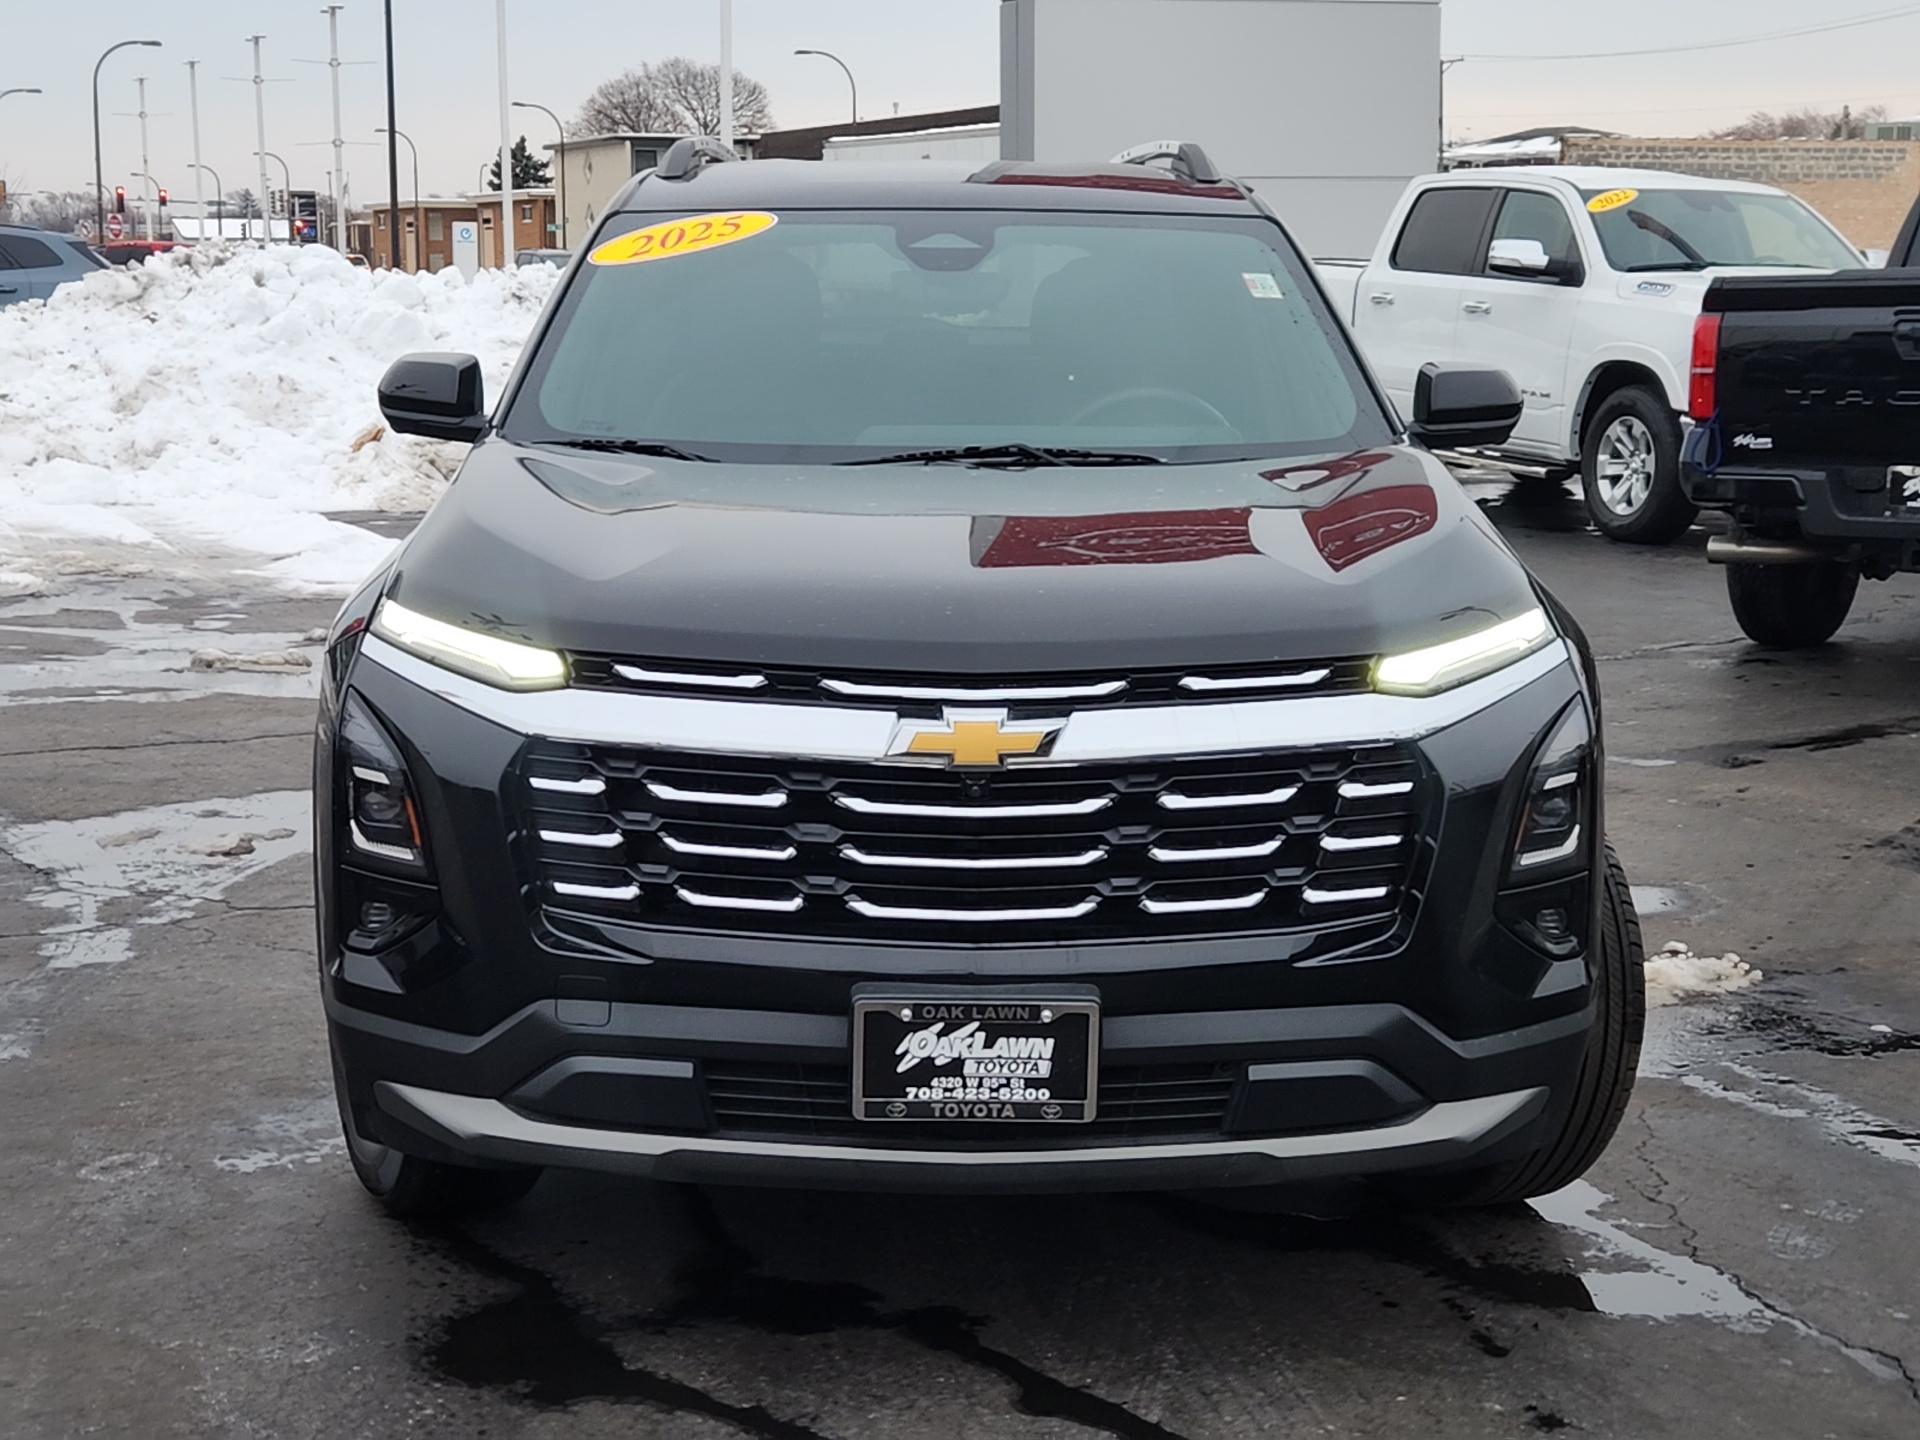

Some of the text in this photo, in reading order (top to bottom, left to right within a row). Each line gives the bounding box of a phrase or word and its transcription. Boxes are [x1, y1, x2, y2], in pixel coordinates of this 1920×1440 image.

[1597, 190, 1630, 209] 2022
[627, 214, 744, 259] 2025
[922, 1005, 1030, 1020] OAK LAWN
[974, 1060, 1040, 1075] TOYOTA
[930, 1077, 963, 1088] 4320
[966, 1077, 980, 1088] W
[1010, 1077, 1025, 1089] St
[905, 1087, 1051, 1100] 708-423-5200
[930, 1103, 1016, 1118] TOYOTA
